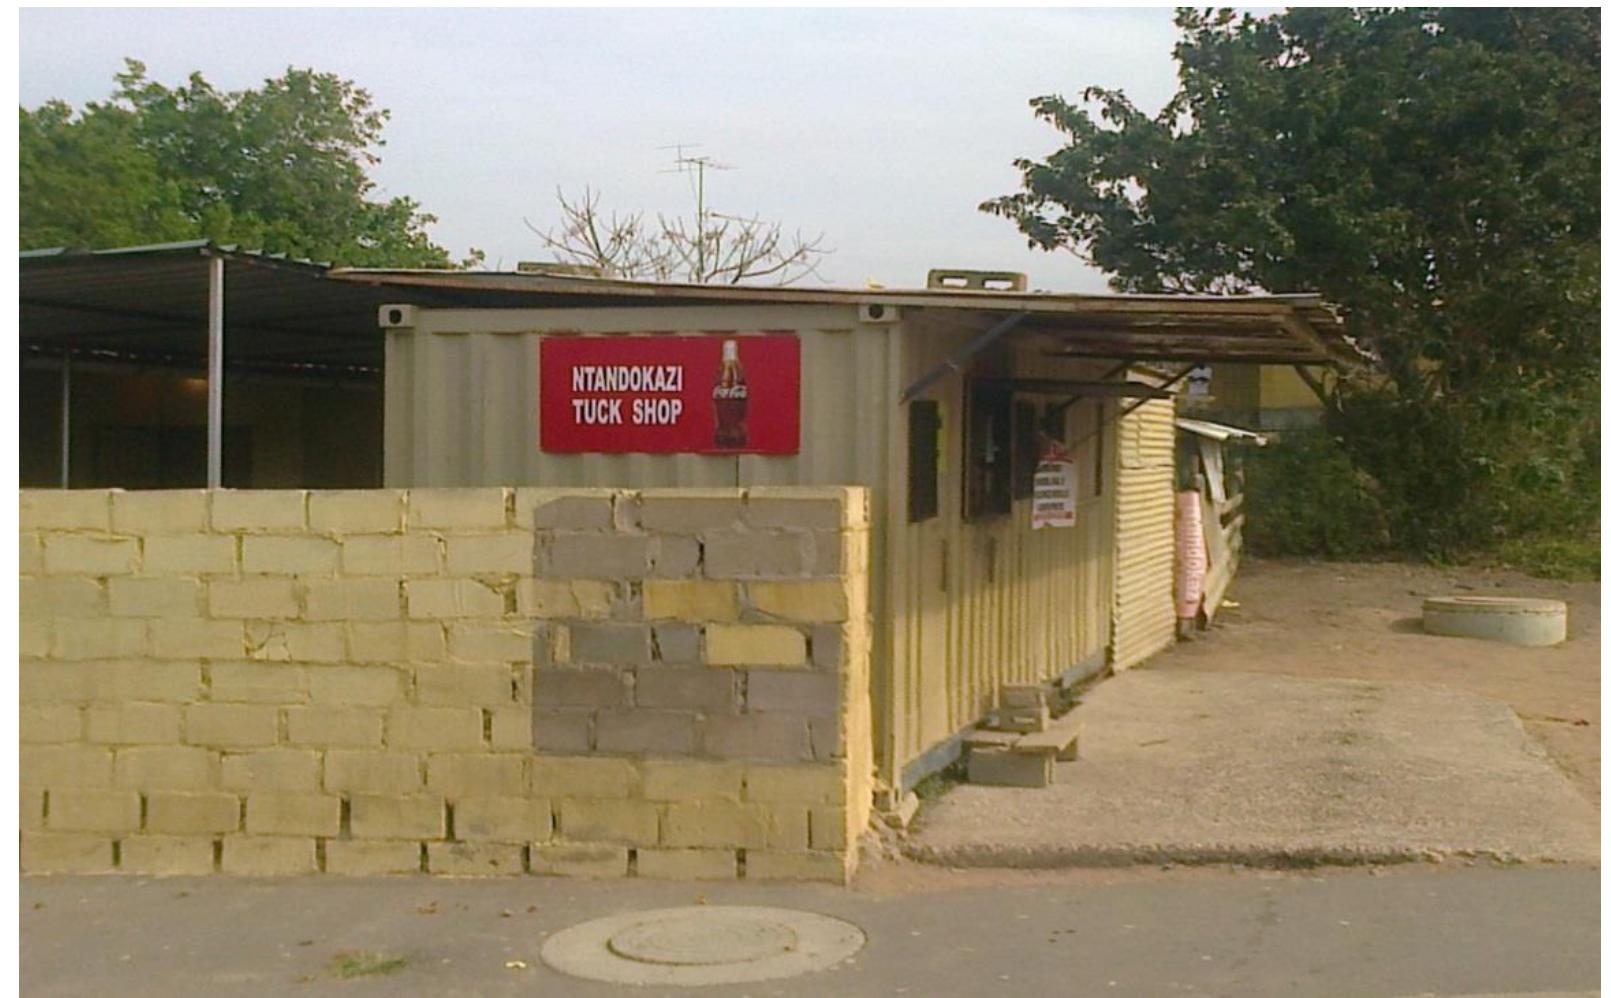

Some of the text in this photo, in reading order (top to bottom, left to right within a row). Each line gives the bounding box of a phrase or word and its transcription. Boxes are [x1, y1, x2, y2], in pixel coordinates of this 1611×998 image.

[572, 366, 682, 391] NTANDOKAZI
[572, 399, 682, 424] TUCK SHOP
